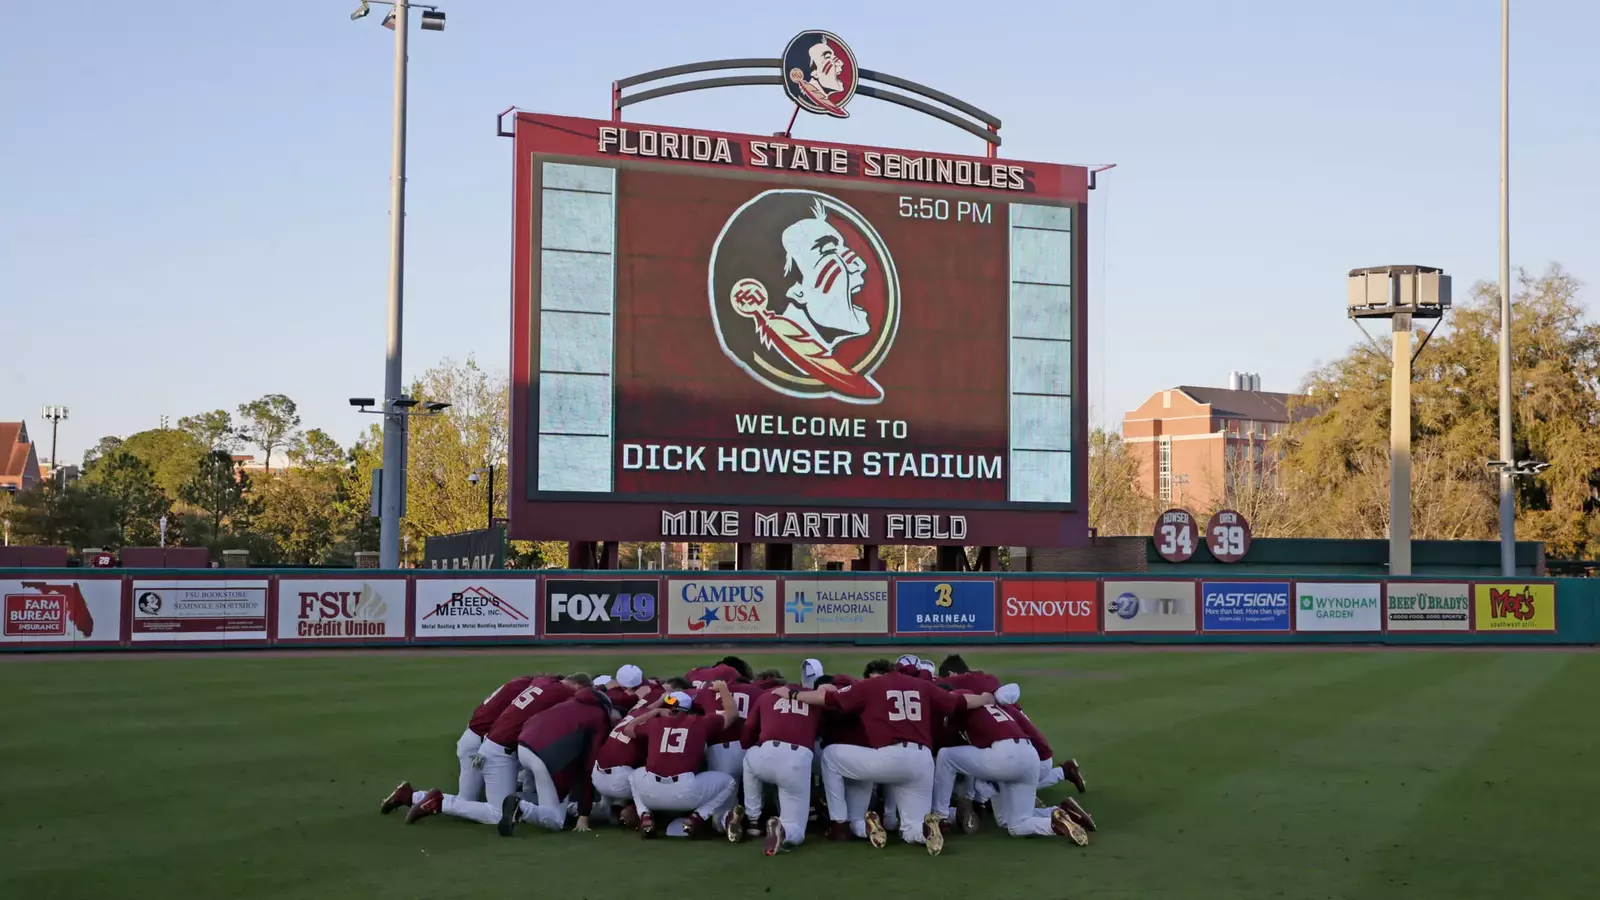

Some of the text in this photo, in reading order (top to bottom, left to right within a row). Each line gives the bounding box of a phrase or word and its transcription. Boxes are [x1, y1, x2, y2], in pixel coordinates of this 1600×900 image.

[598, 126, 1025, 190] FLORIDA STATE SEMINOLES
[899, 196, 992, 224] 5:50 PM
[733, 289, 767, 306] FSU
[735, 413, 908, 439] WELCOME TO
[622, 443, 1002, 479] DICK HOWSER STADIUM
[661, 510, 967, 540] MIKE MARTIN FIELD
[1163, 512, 1189, 524] HOWSER
[1161, 525, 1192, 555] 34
[1213, 526, 1244, 555] 39
[99, 556, 110, 565] 28
[451, 592, 500, 607] REED'S
[682, 583, 764, 603] CAMPUS
[816, 591, 888, 601] TALLAHASSEE
[1205, 593, 1287, 607] FASTSIGNS
[25, 599, 60, 610] FARM
[298, 591, 361, 619] FSU
[436, 604, 486, 616] METALS,
[816, 603, 875, 614] MEMORIAL
[1006, 597, 1091, 616] SYNOVUS
[1316, 598, 1377, 609] WYNDHAM
[1388, 596, 1416, 610] BEEF
[10, 610, 60, 621] BUREAU
[724, 605, 760, 622] USA
[916, 614, 976, 622] BARINEAU
[1316, 610, 1354, 619] GARDEN
[19, 623, 60, 631] INSURANCE
[298, 620, 386, 637] Credit Union
[774, 698, 809, 716] 40
[886, 690, 922, 721] 36
[660, 727, 689, 754] 13
